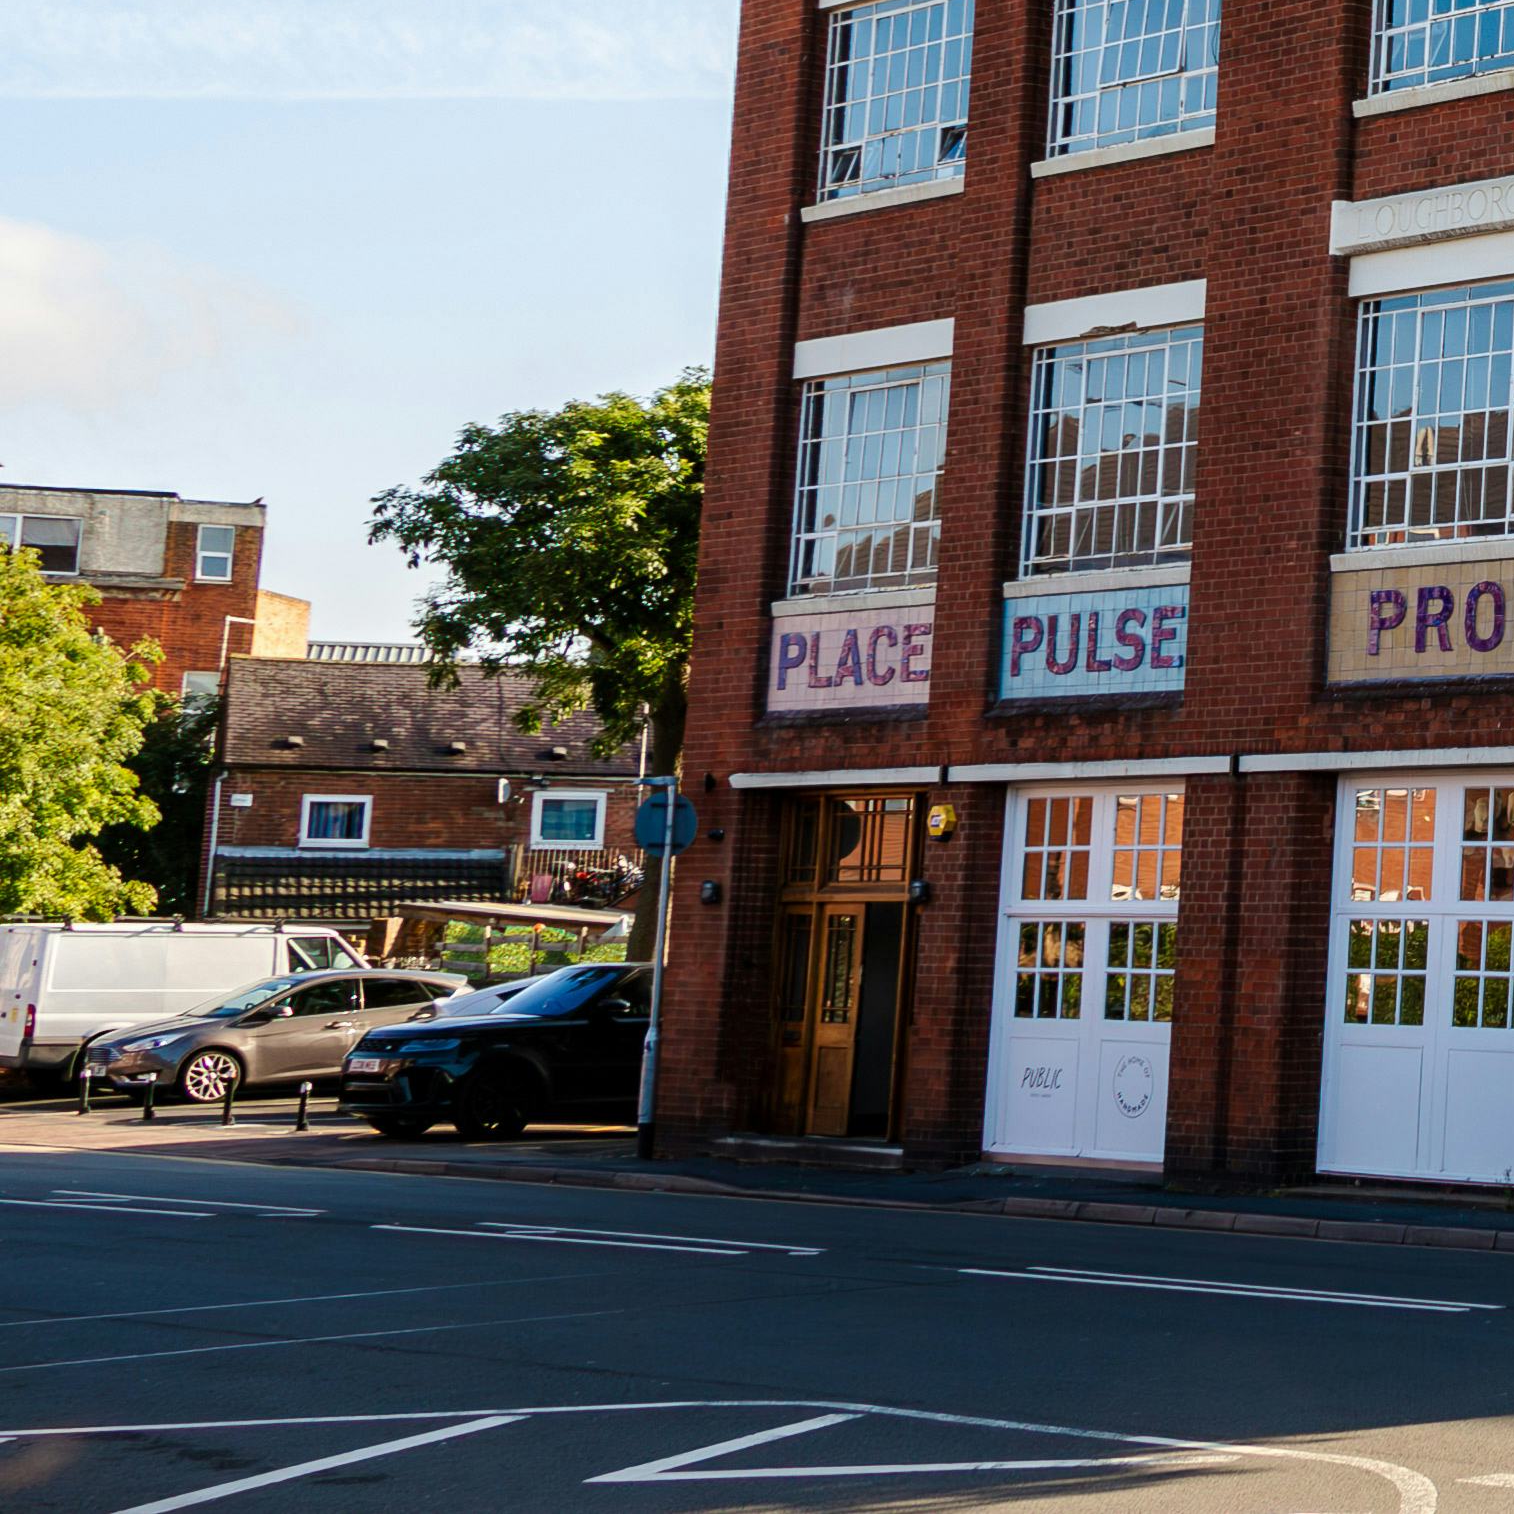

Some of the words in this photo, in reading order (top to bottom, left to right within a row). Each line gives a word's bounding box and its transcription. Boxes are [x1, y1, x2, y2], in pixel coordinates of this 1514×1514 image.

[775, 622, 934, 692] PLACE
[1009, 604, 1187, 679] PULSE
[1020, 1067, 1063, 1089] PUBLIC
